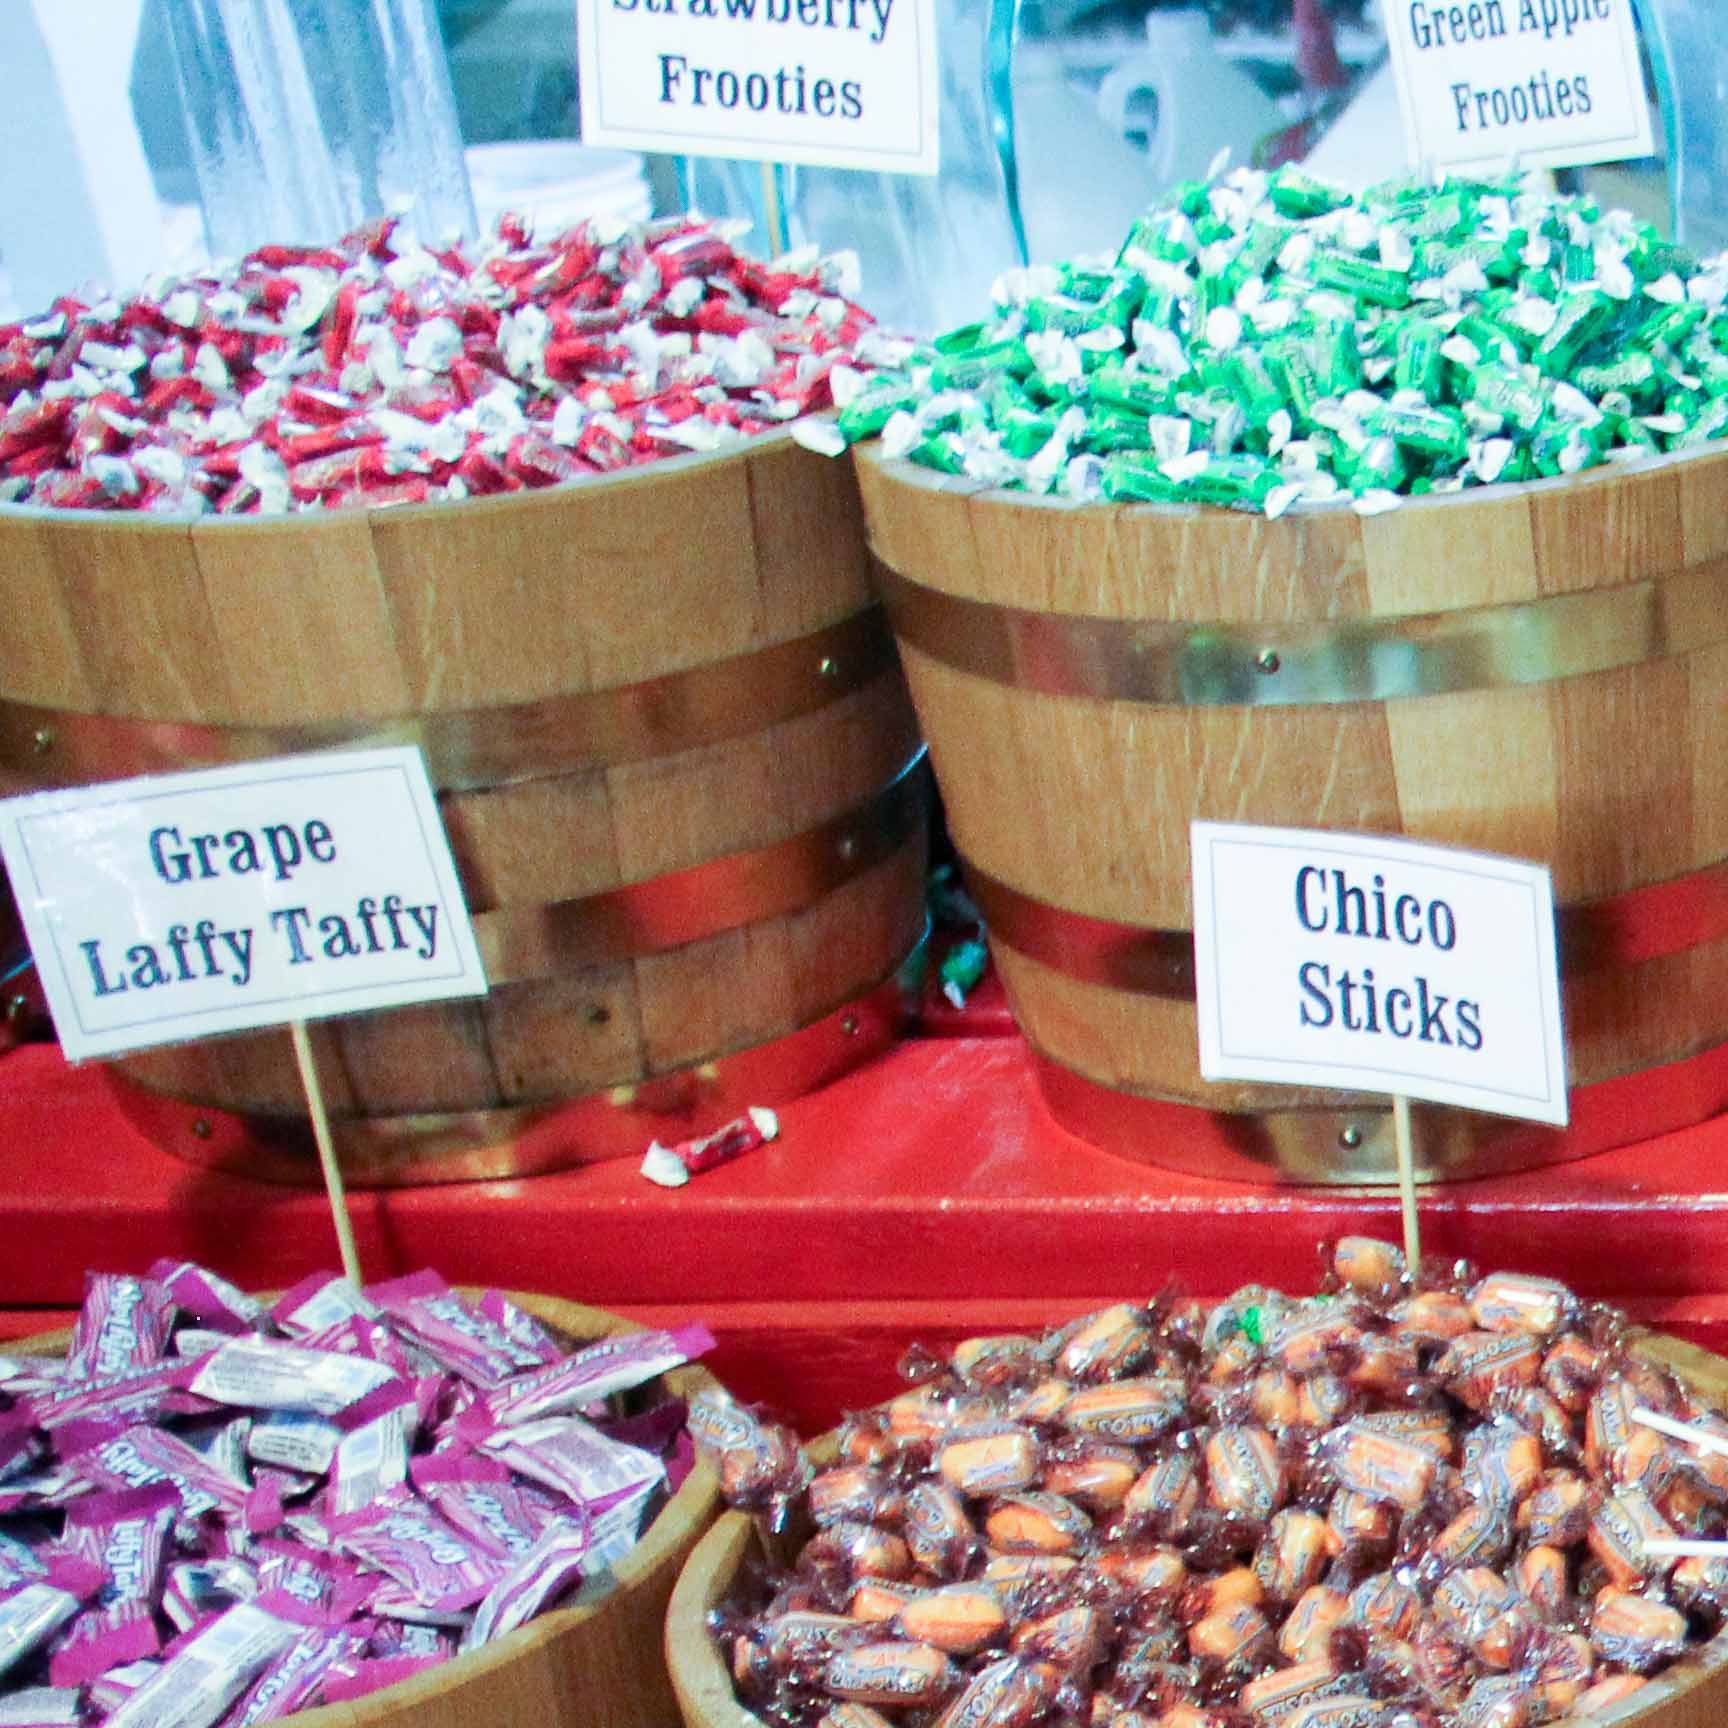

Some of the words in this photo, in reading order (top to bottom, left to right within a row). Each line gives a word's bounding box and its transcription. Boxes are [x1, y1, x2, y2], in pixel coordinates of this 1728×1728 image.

[612, 0, 893, 43] awberry
[1410, 1, 1507, 50] Green
[658, 54, 863, 120] Frooties
[1451, 69, 1591, 131] Frooties
[149, 817, 337, 885] Grape
[1294, 865, 1457, 952] Chico
[79, 920, 253, 997] Laffy
[271, 895, 439, 965] Taffy
[1298, 961, 1484, 1051] Sticks
